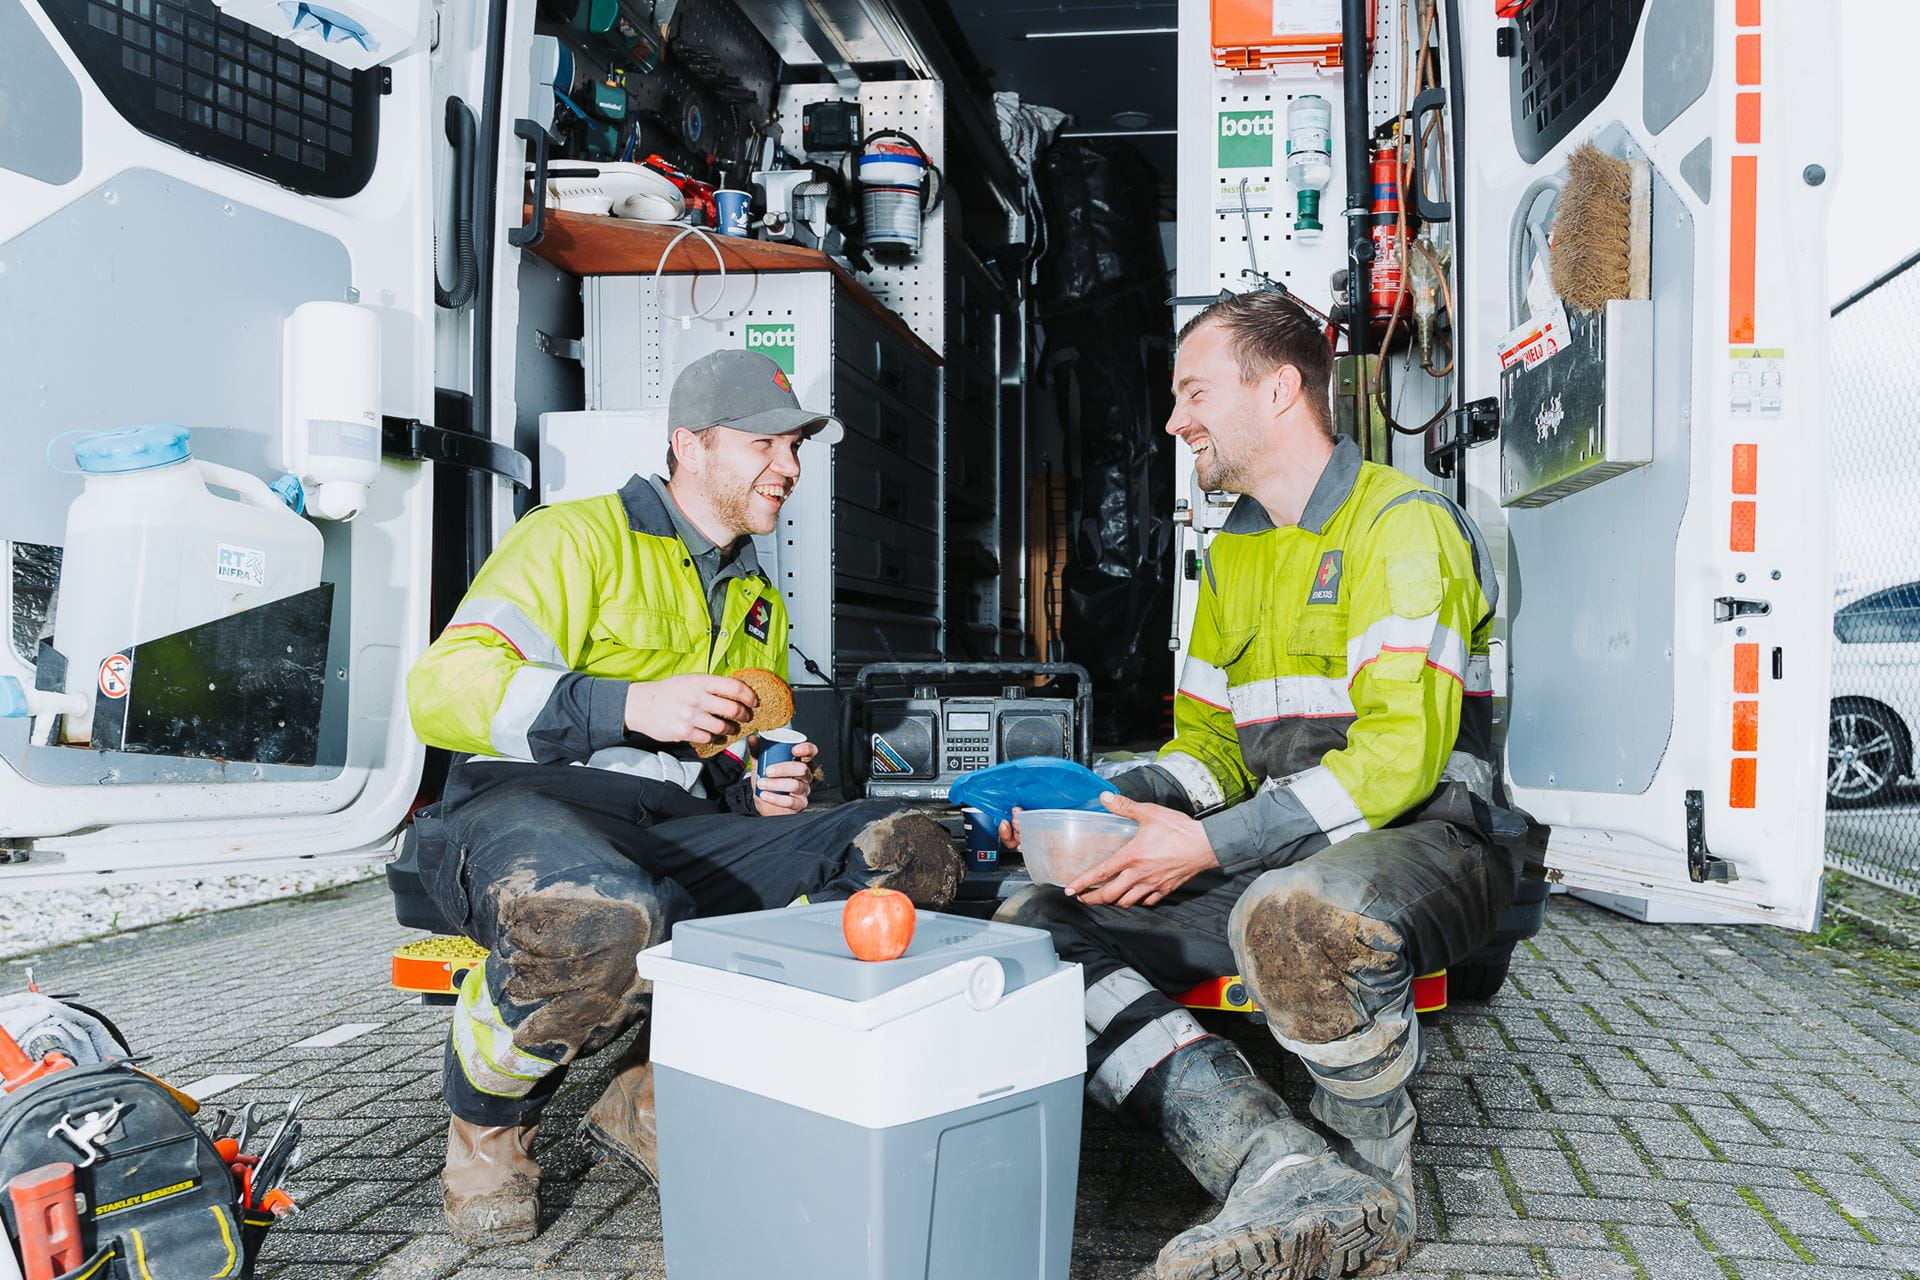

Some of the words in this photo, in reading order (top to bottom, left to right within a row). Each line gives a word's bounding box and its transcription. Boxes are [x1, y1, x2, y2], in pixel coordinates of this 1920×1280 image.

[1221, 115, 1274, 136] bott
[748, 328, 795, 347] bott
[220, 549, 245, 567] RT
[218, 566, 250, 580] INFRA
